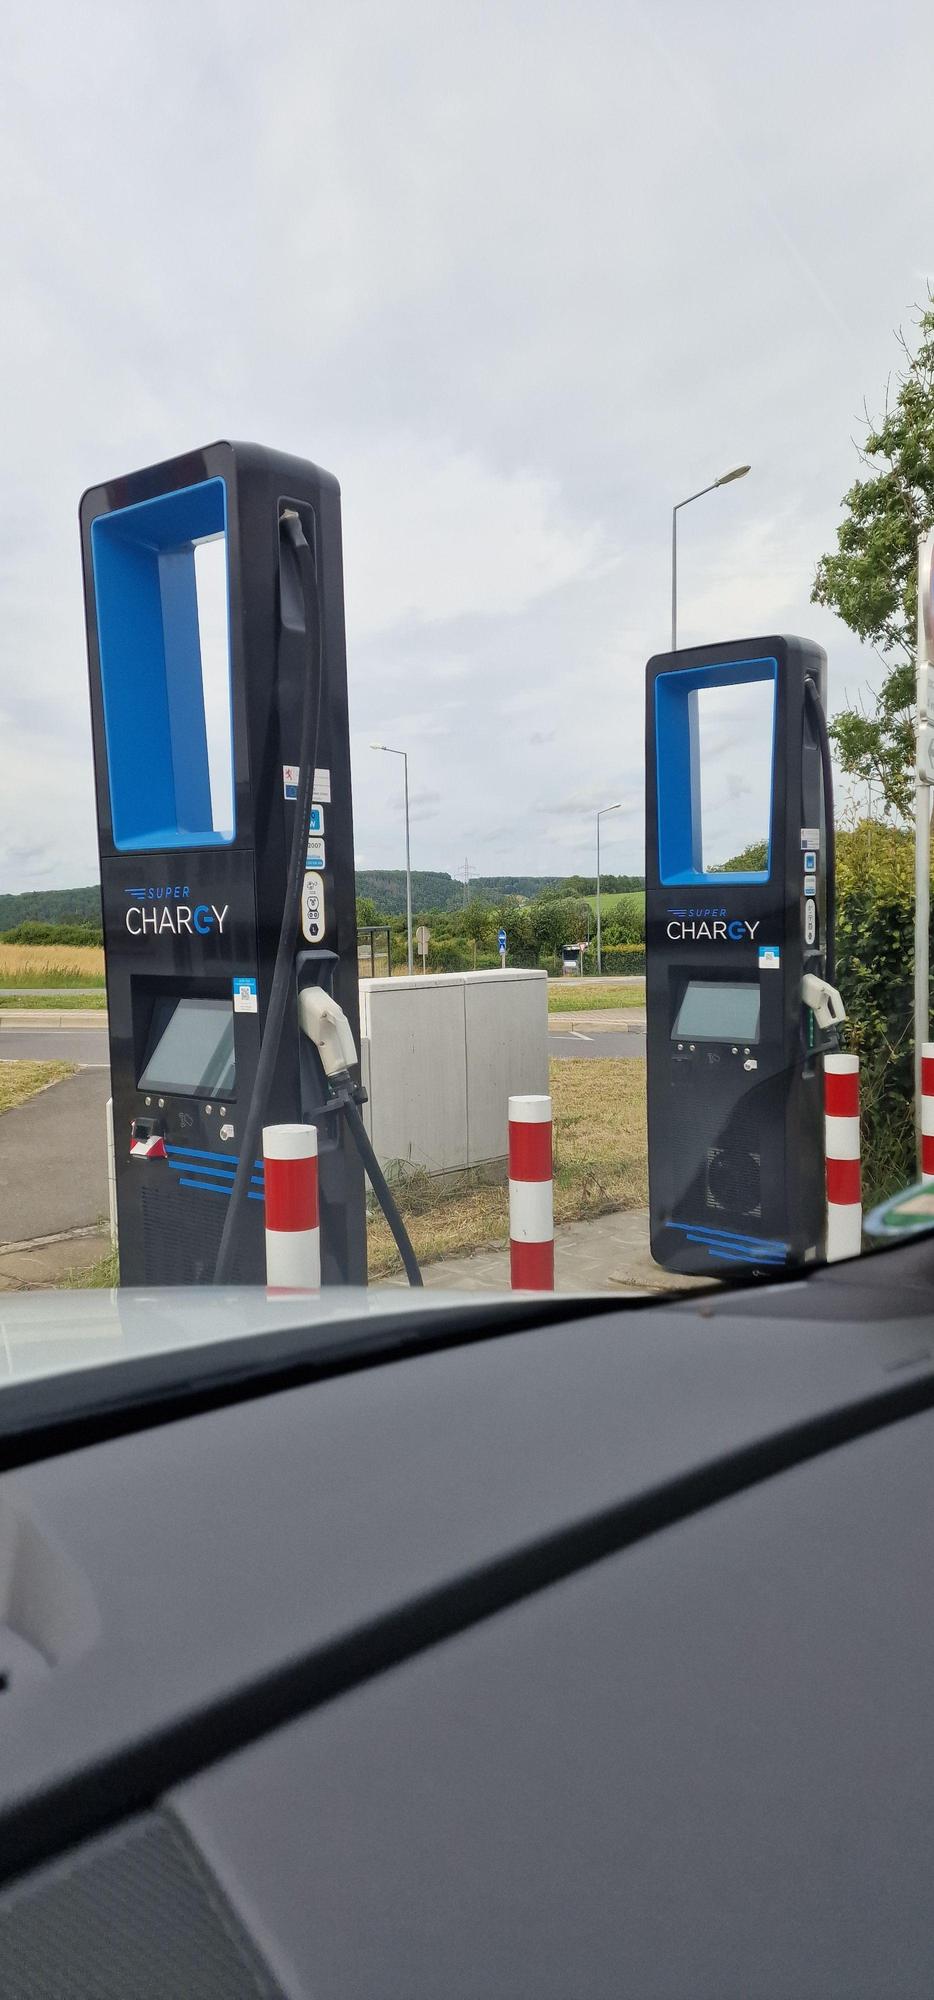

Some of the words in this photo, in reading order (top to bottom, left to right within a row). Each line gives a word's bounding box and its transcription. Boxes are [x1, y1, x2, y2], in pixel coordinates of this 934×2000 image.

[147, 886, 191, 899] SUPER
[125, 904, 229, 935] CHARGY
[688, 908, 727, 917] SUPER
[666, 920, 760, 941] CHARGY
